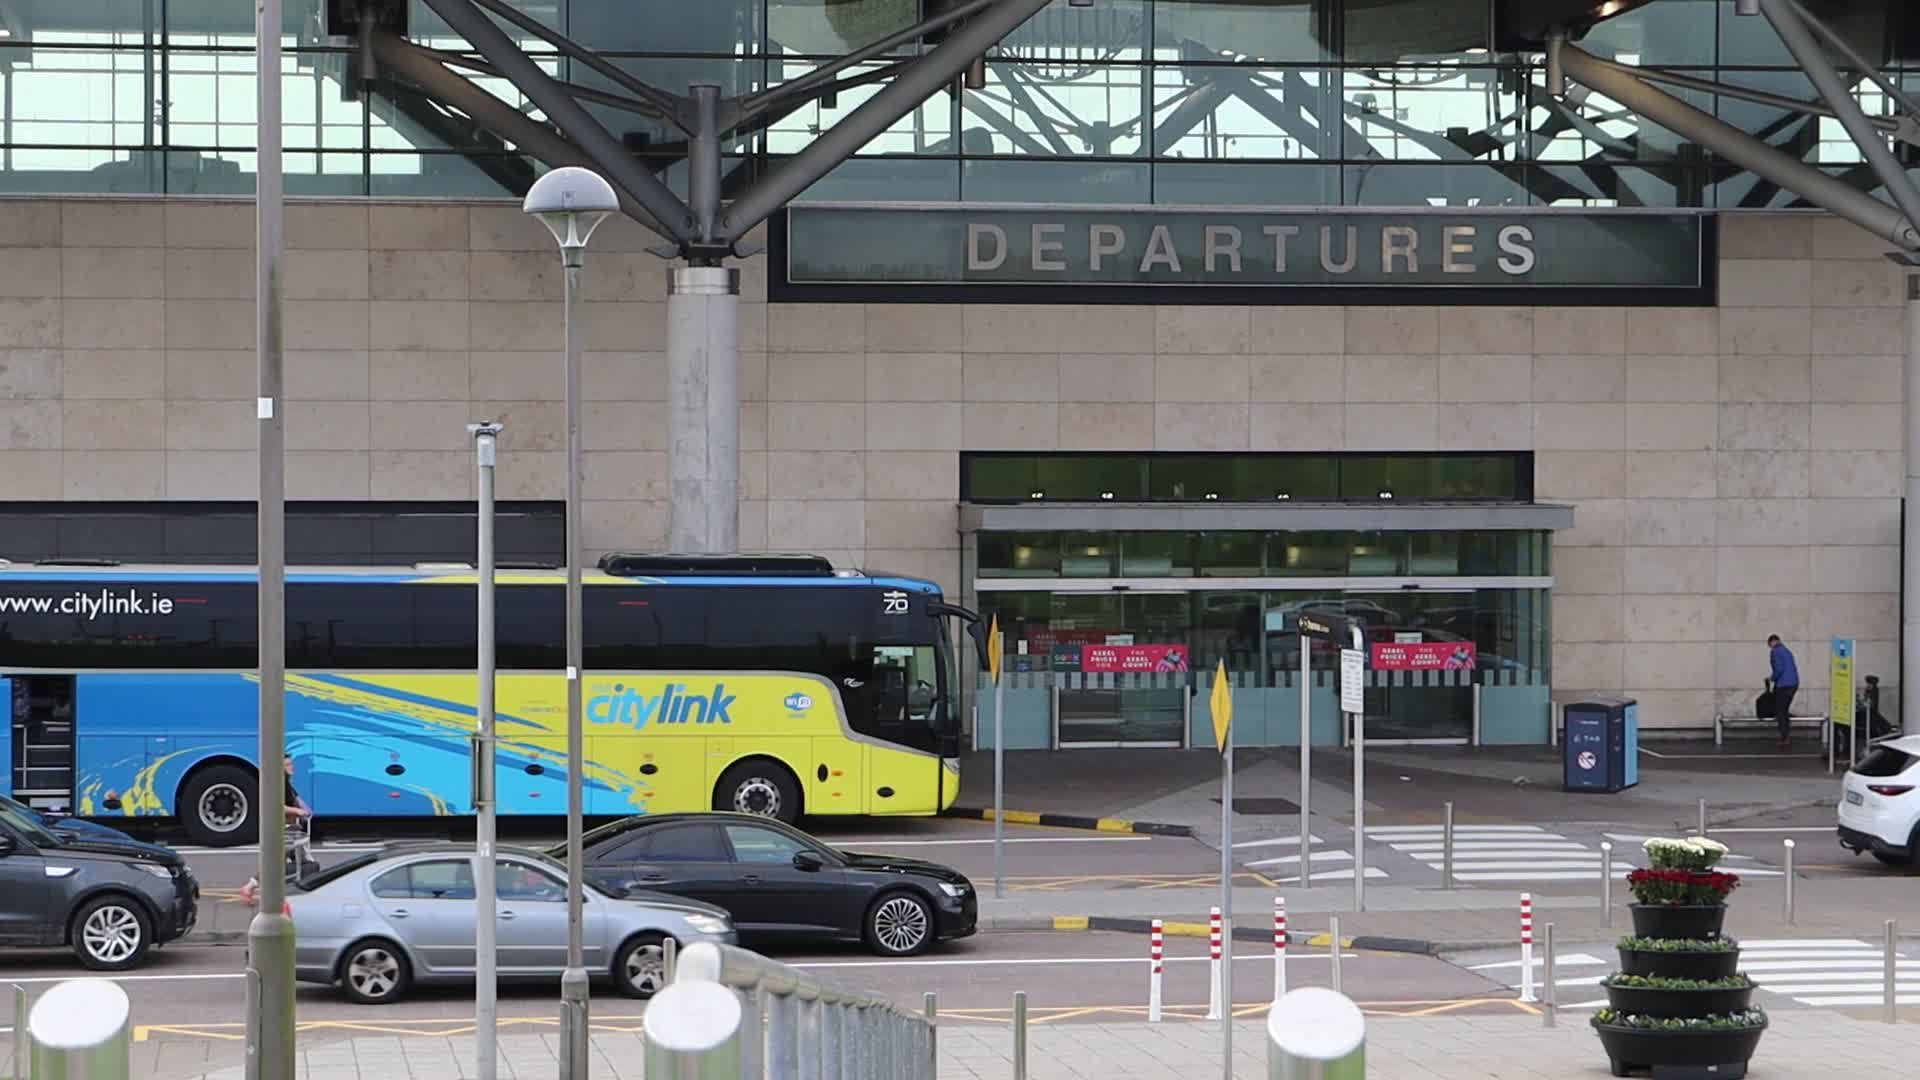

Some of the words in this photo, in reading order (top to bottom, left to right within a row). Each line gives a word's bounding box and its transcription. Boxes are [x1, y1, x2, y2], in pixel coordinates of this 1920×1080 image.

[968, 223, 1536, 274] DEPARTURES
[883, 599, 908, 611] 70
[586, 683, 737, 730] citylink
